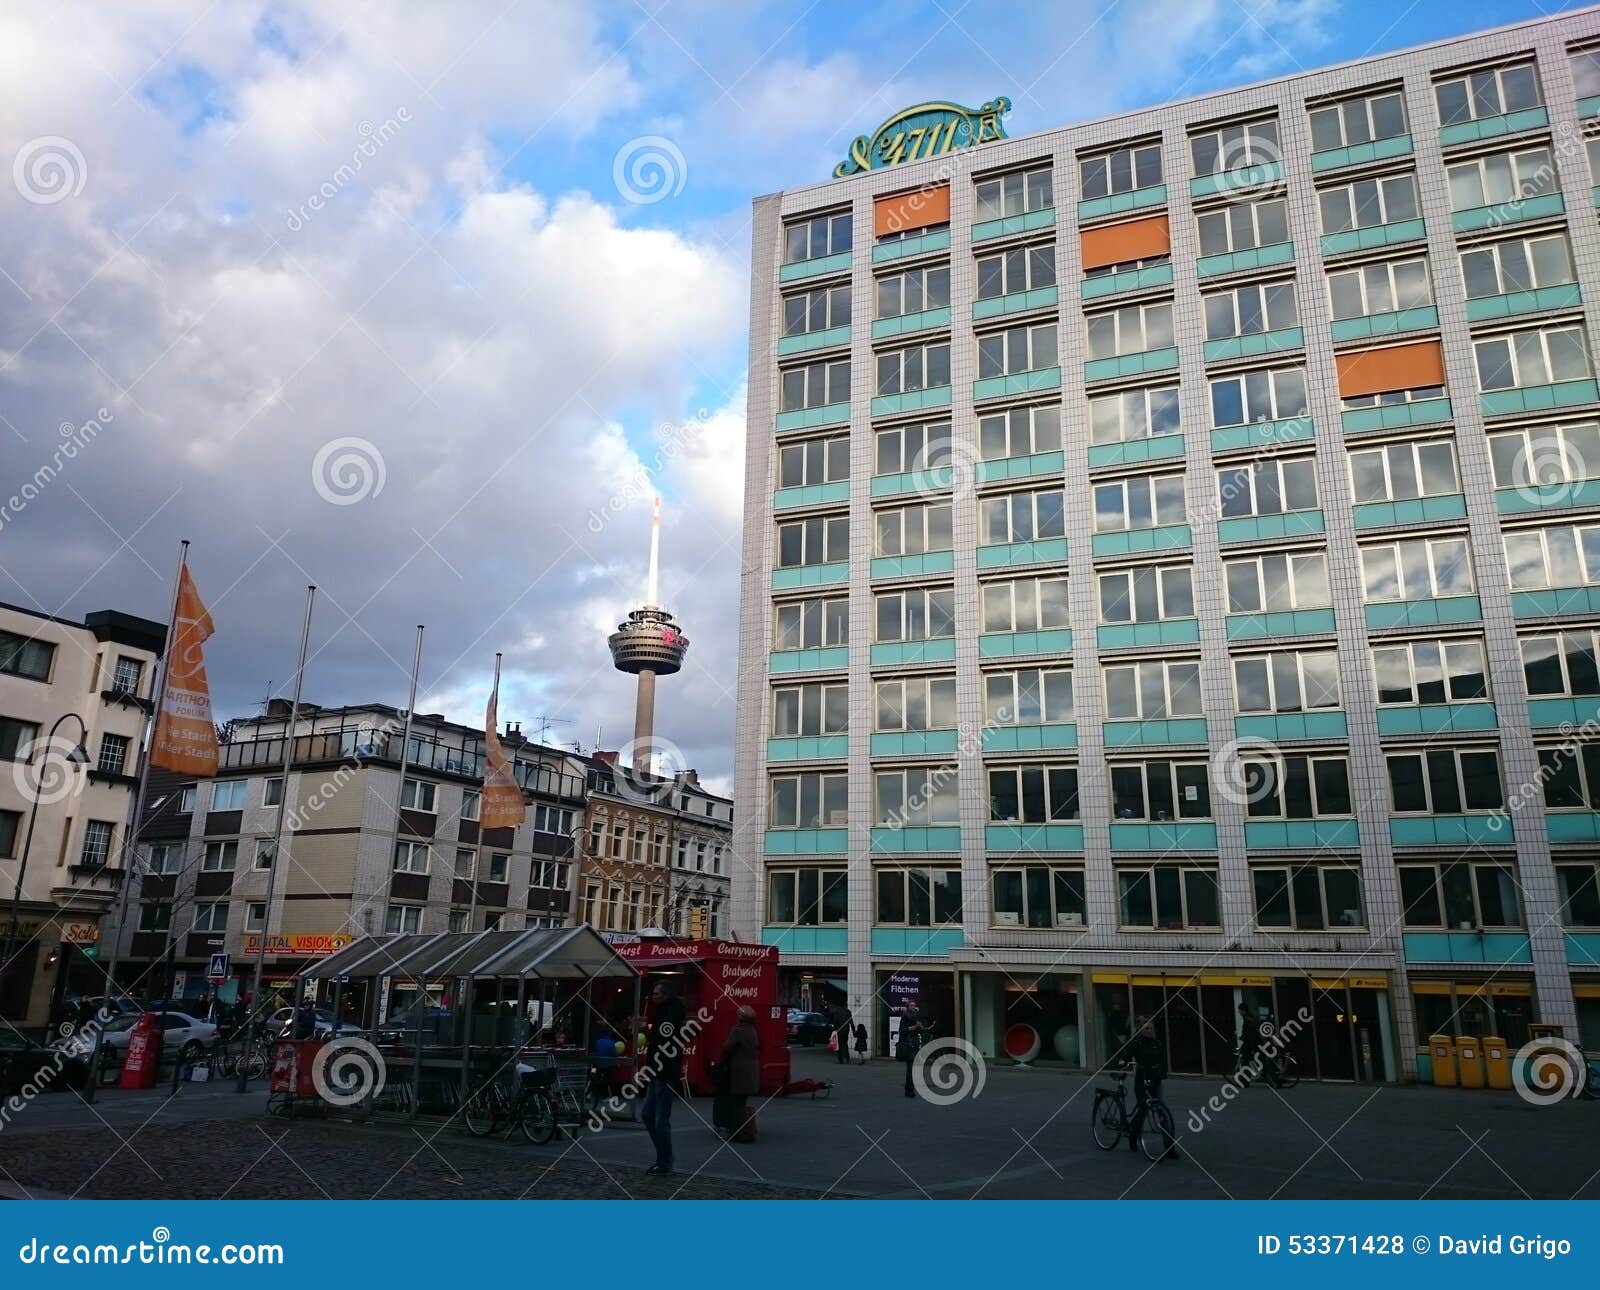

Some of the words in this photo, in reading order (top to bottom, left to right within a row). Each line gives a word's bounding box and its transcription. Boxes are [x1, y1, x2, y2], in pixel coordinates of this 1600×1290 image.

[296, 936, 332, 948] VISION
[650, 944, 699, 956] Pommes
[717, 942, 771, 957] Currywurst
[722, 963, 762, 979] Bratwurst
[891, 975, 920, 983] Moderne
[724, 984, 758, 998] Pommes
